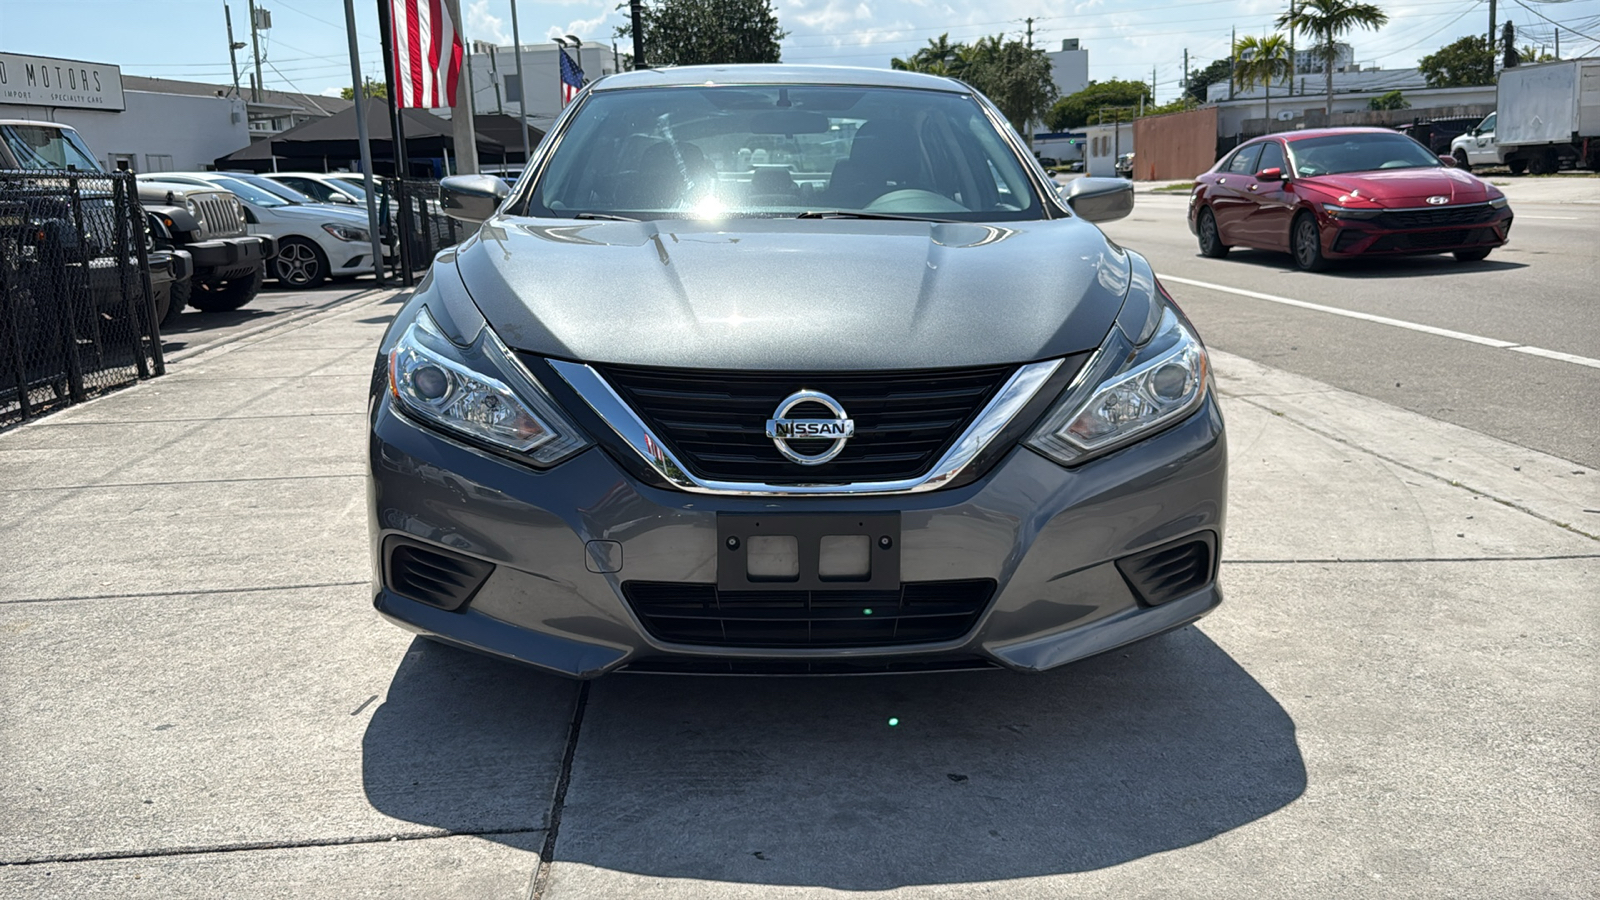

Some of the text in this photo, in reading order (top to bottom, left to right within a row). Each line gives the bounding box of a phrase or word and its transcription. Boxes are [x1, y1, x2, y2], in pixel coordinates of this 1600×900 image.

[25, 63, 101, 92] MOTORS
[4, 90, 103, 104] IMPORT SPECIALTY CARS
[775, 423, 845, 434] NISSAN
